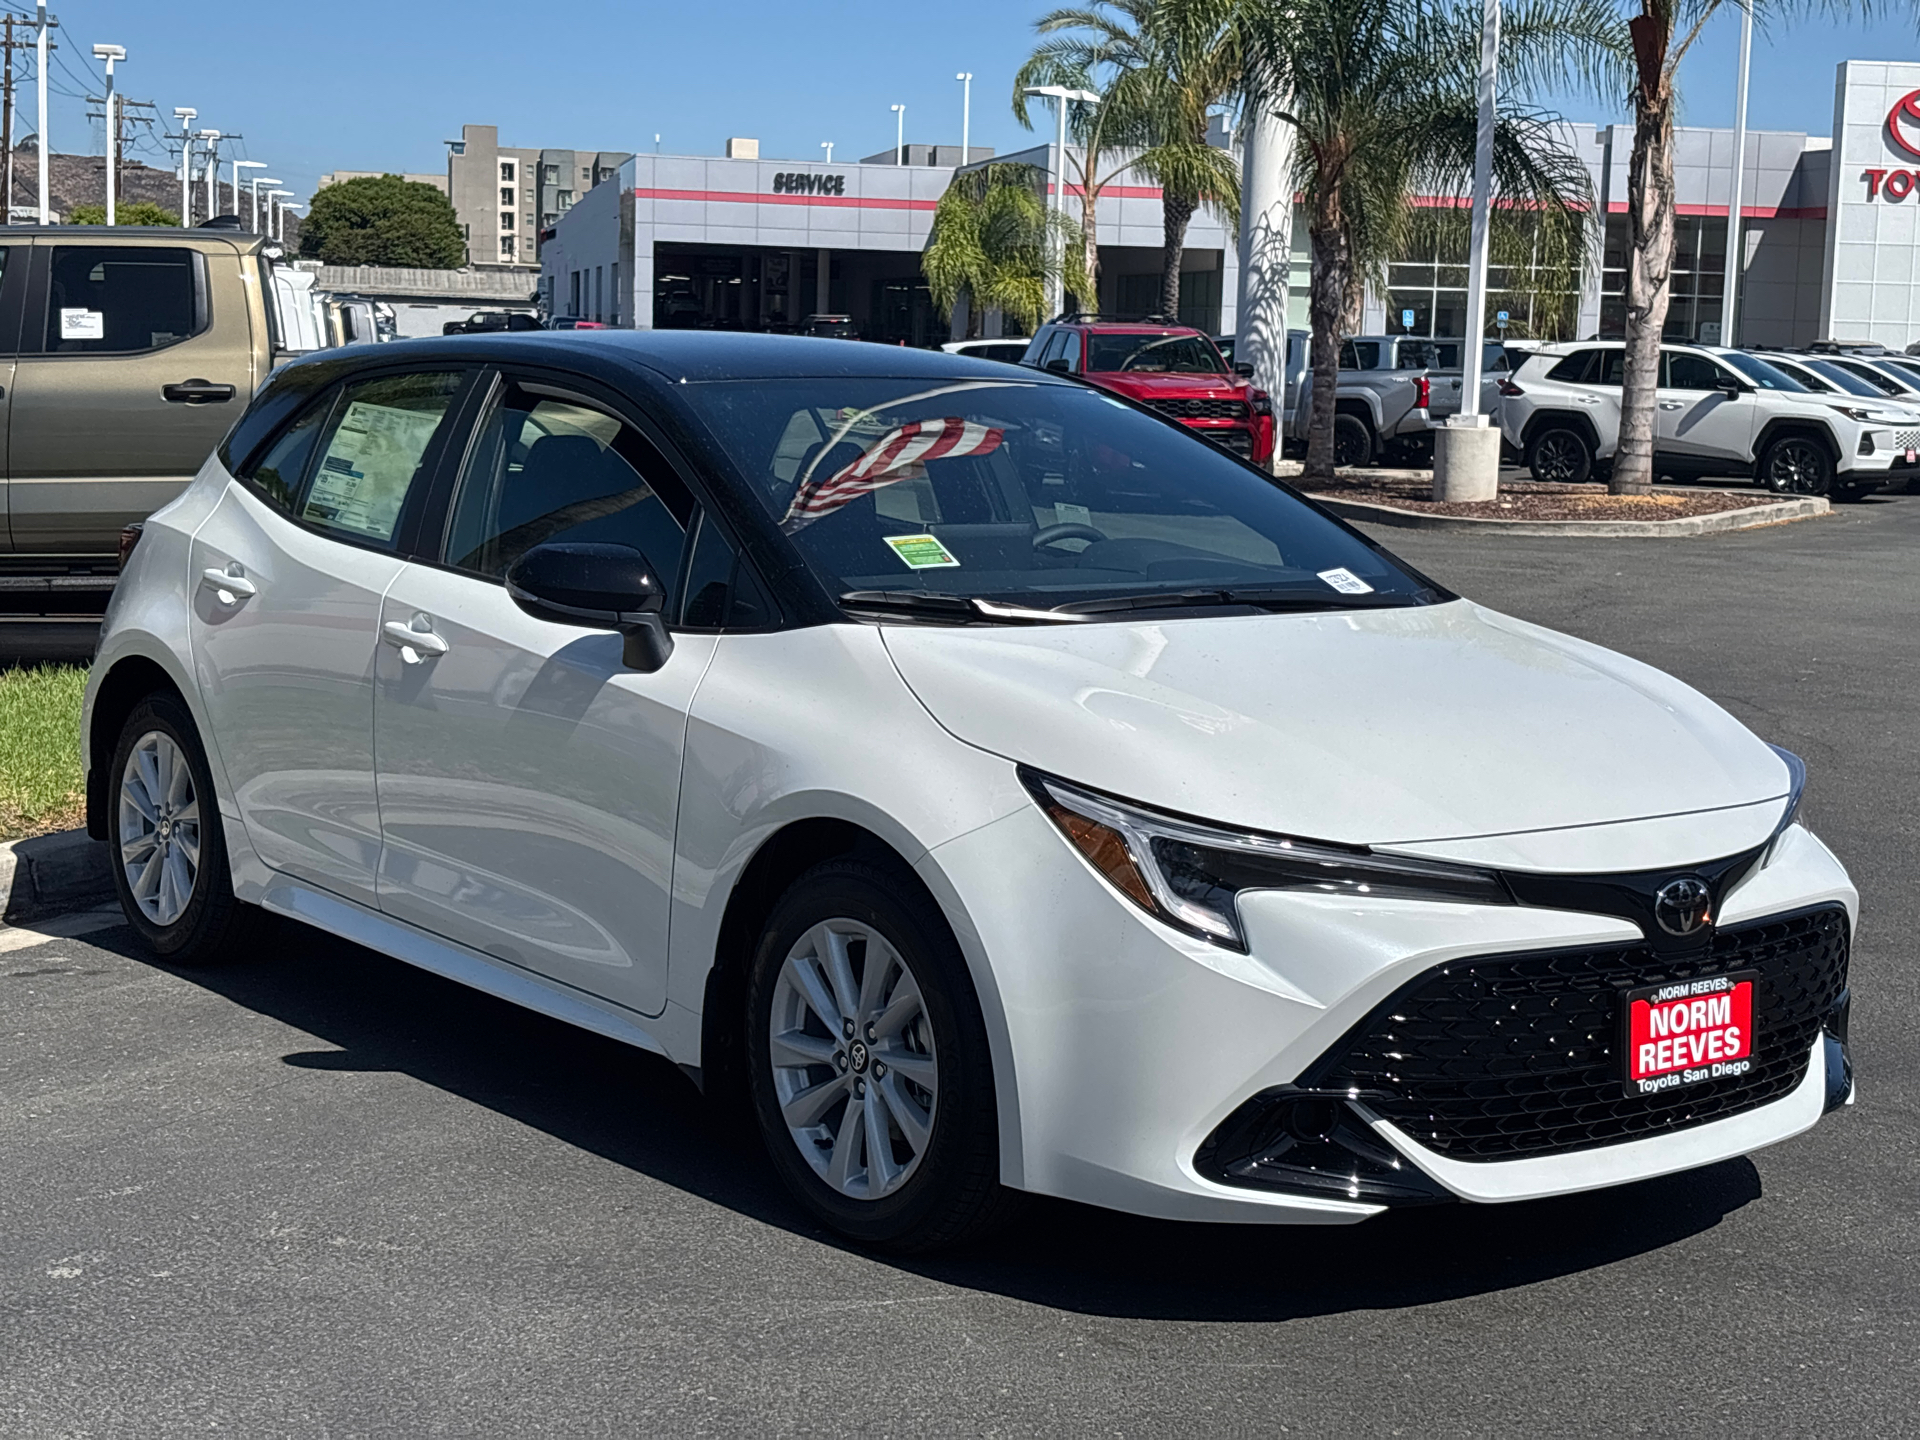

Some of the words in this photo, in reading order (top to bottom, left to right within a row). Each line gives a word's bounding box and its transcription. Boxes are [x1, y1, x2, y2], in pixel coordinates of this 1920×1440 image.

[774, 172, 845, 194] SERVICE
[1864, 168, 1920, 198] TO
[1658, 984, 1689, 1000] NORM
[1691, 977, 1728, 995] REEVES
[1650, 995, 1731, 1038] NORM
[1639, 1026, 1740, 1074] REEVES
[1637, 1073, 1680, 1093] Toyota
[1683, 1069, 1708, 1082] San
[1712, 1060, 1750, 1077] Diego
